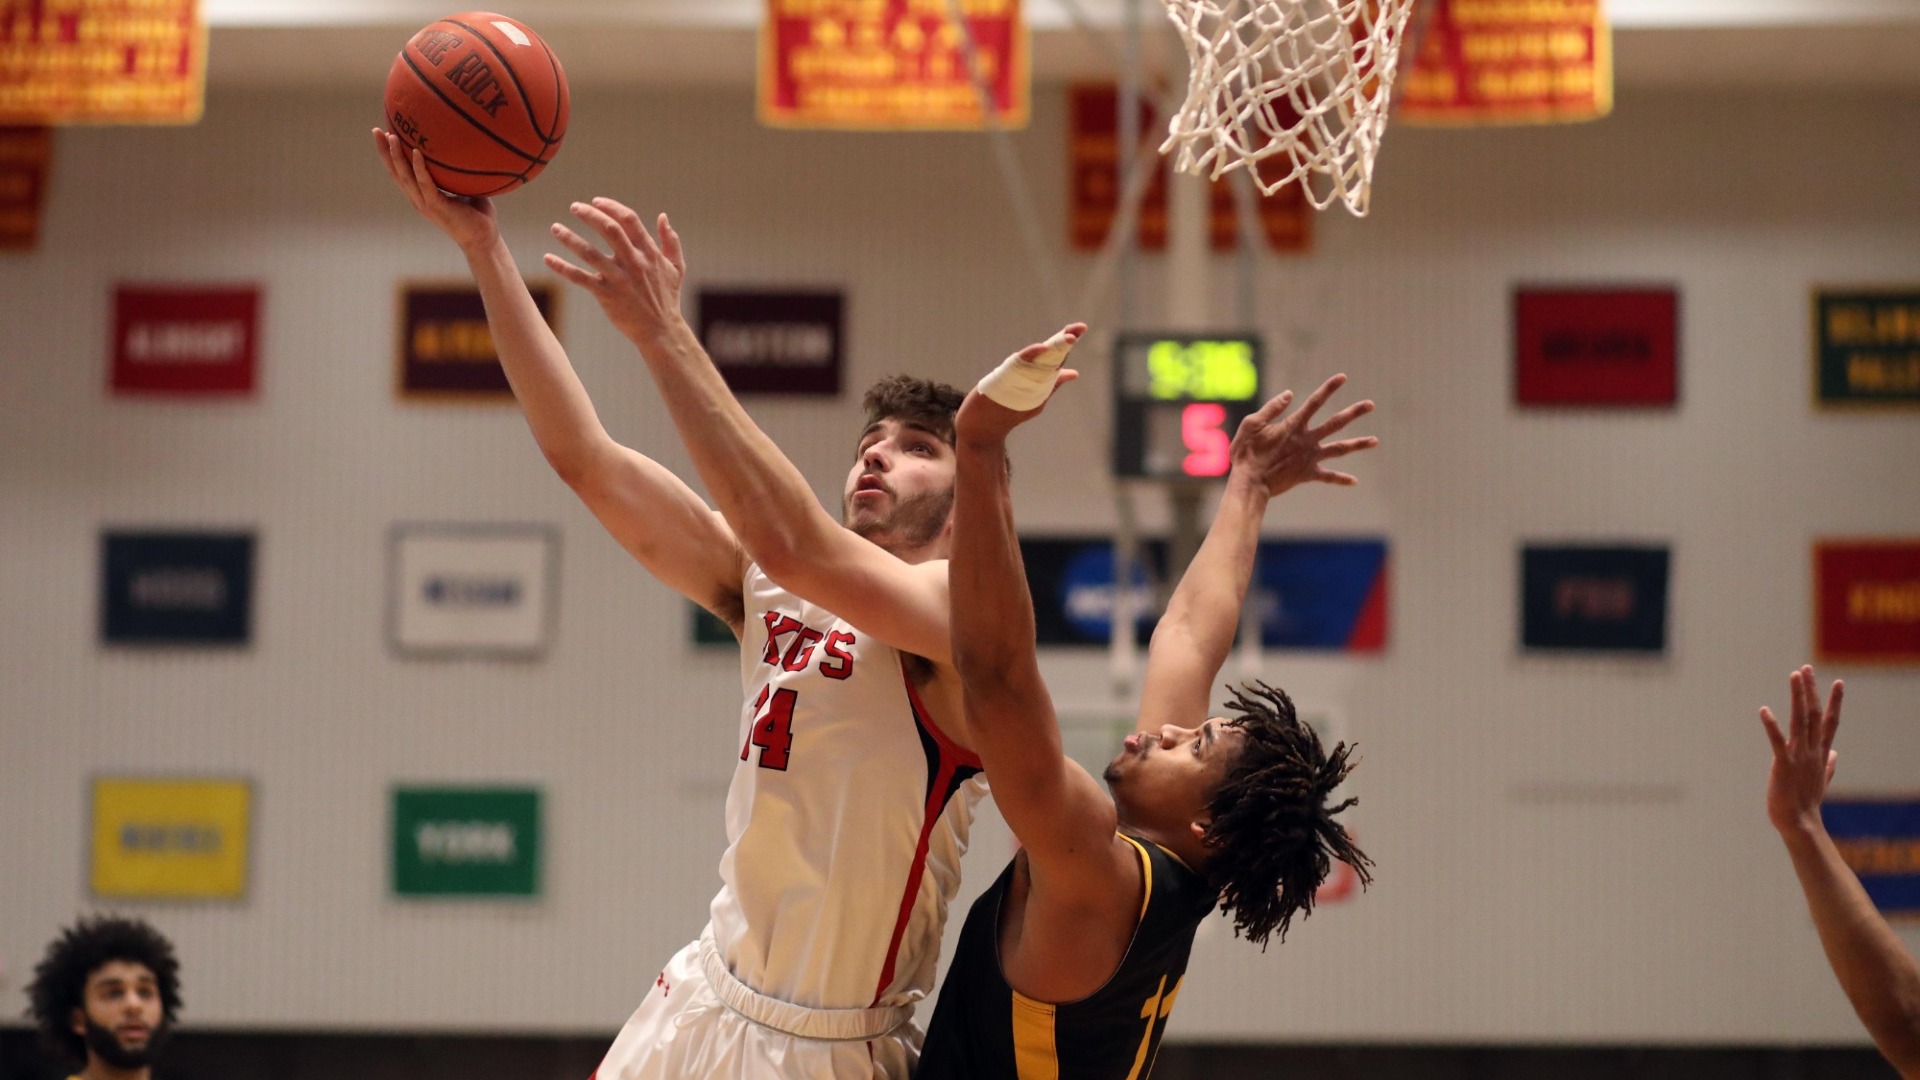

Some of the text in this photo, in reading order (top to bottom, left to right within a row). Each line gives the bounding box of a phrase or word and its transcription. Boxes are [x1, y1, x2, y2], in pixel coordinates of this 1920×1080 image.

[415, 30, 508, 118] THE ROCK
[394, 112, 429, 149] ROCK
[1182, 403, 1230, 476] 5
